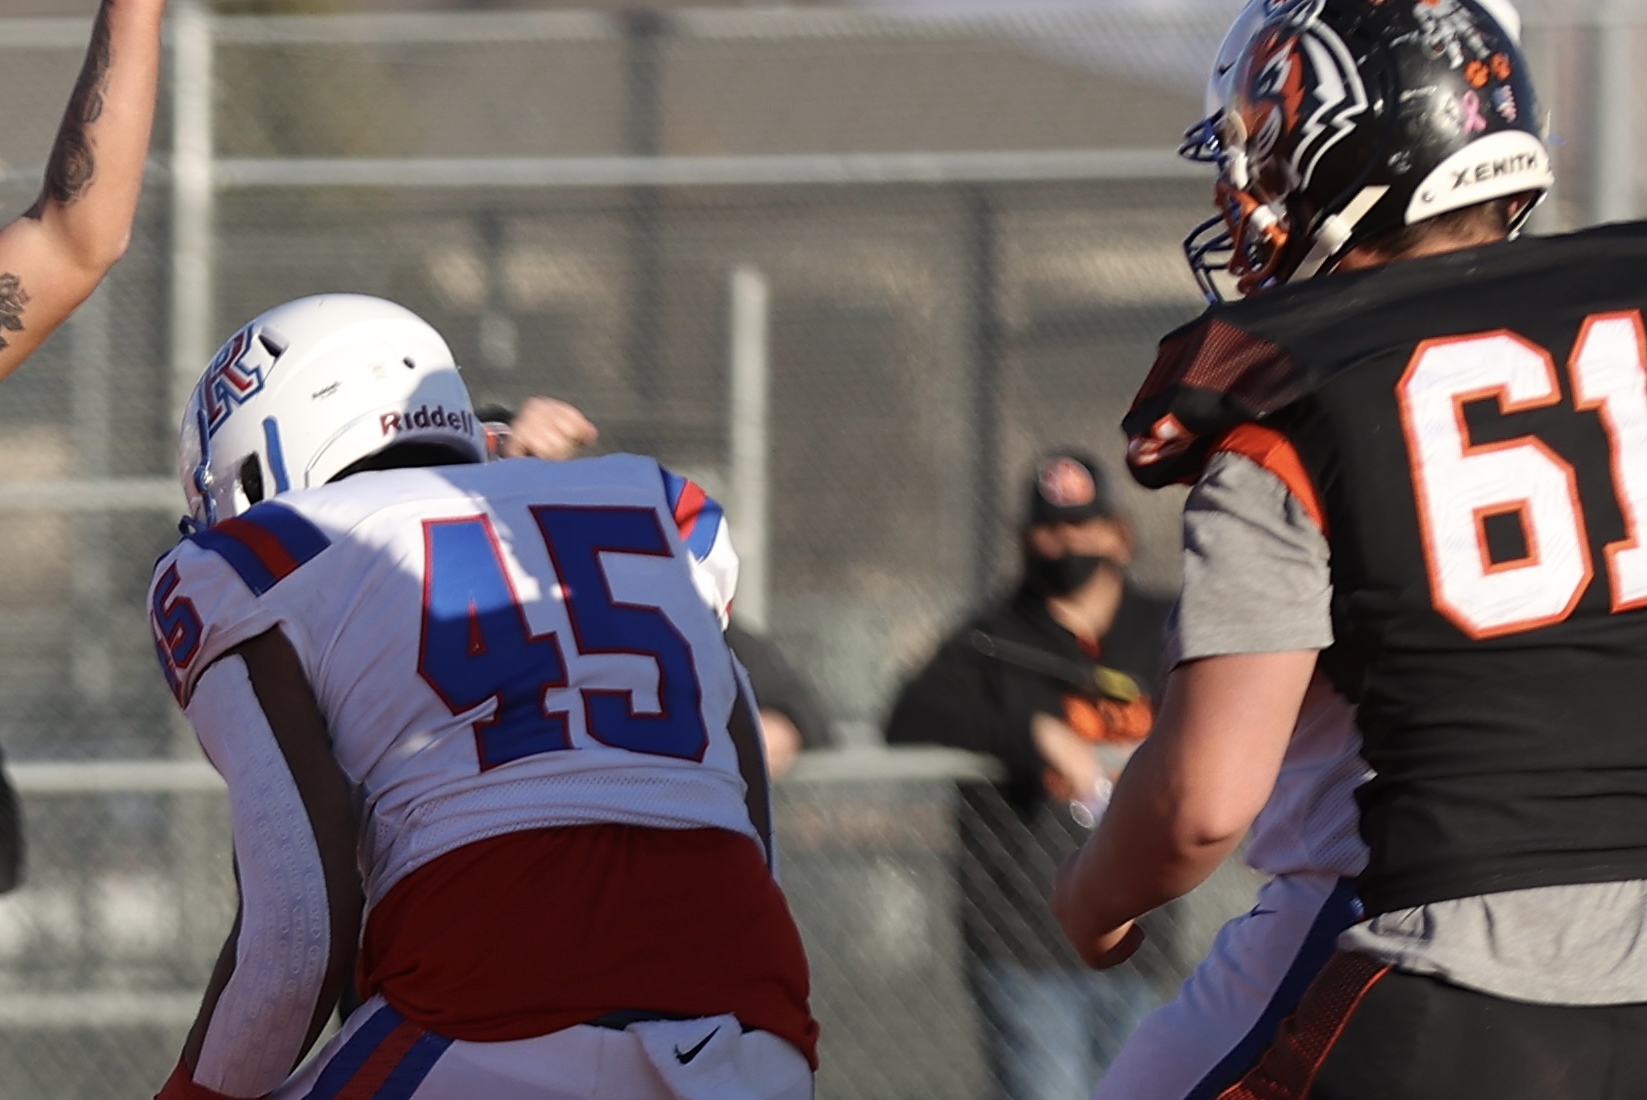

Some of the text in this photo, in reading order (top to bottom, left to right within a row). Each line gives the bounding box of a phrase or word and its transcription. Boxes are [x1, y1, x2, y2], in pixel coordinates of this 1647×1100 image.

[1449, 150, 1538, 190] XENITH
[379, 404, 474, 438] Riddell
[1394, 309, 1647, 641] 61
[417, 504, 710, 773] 45
